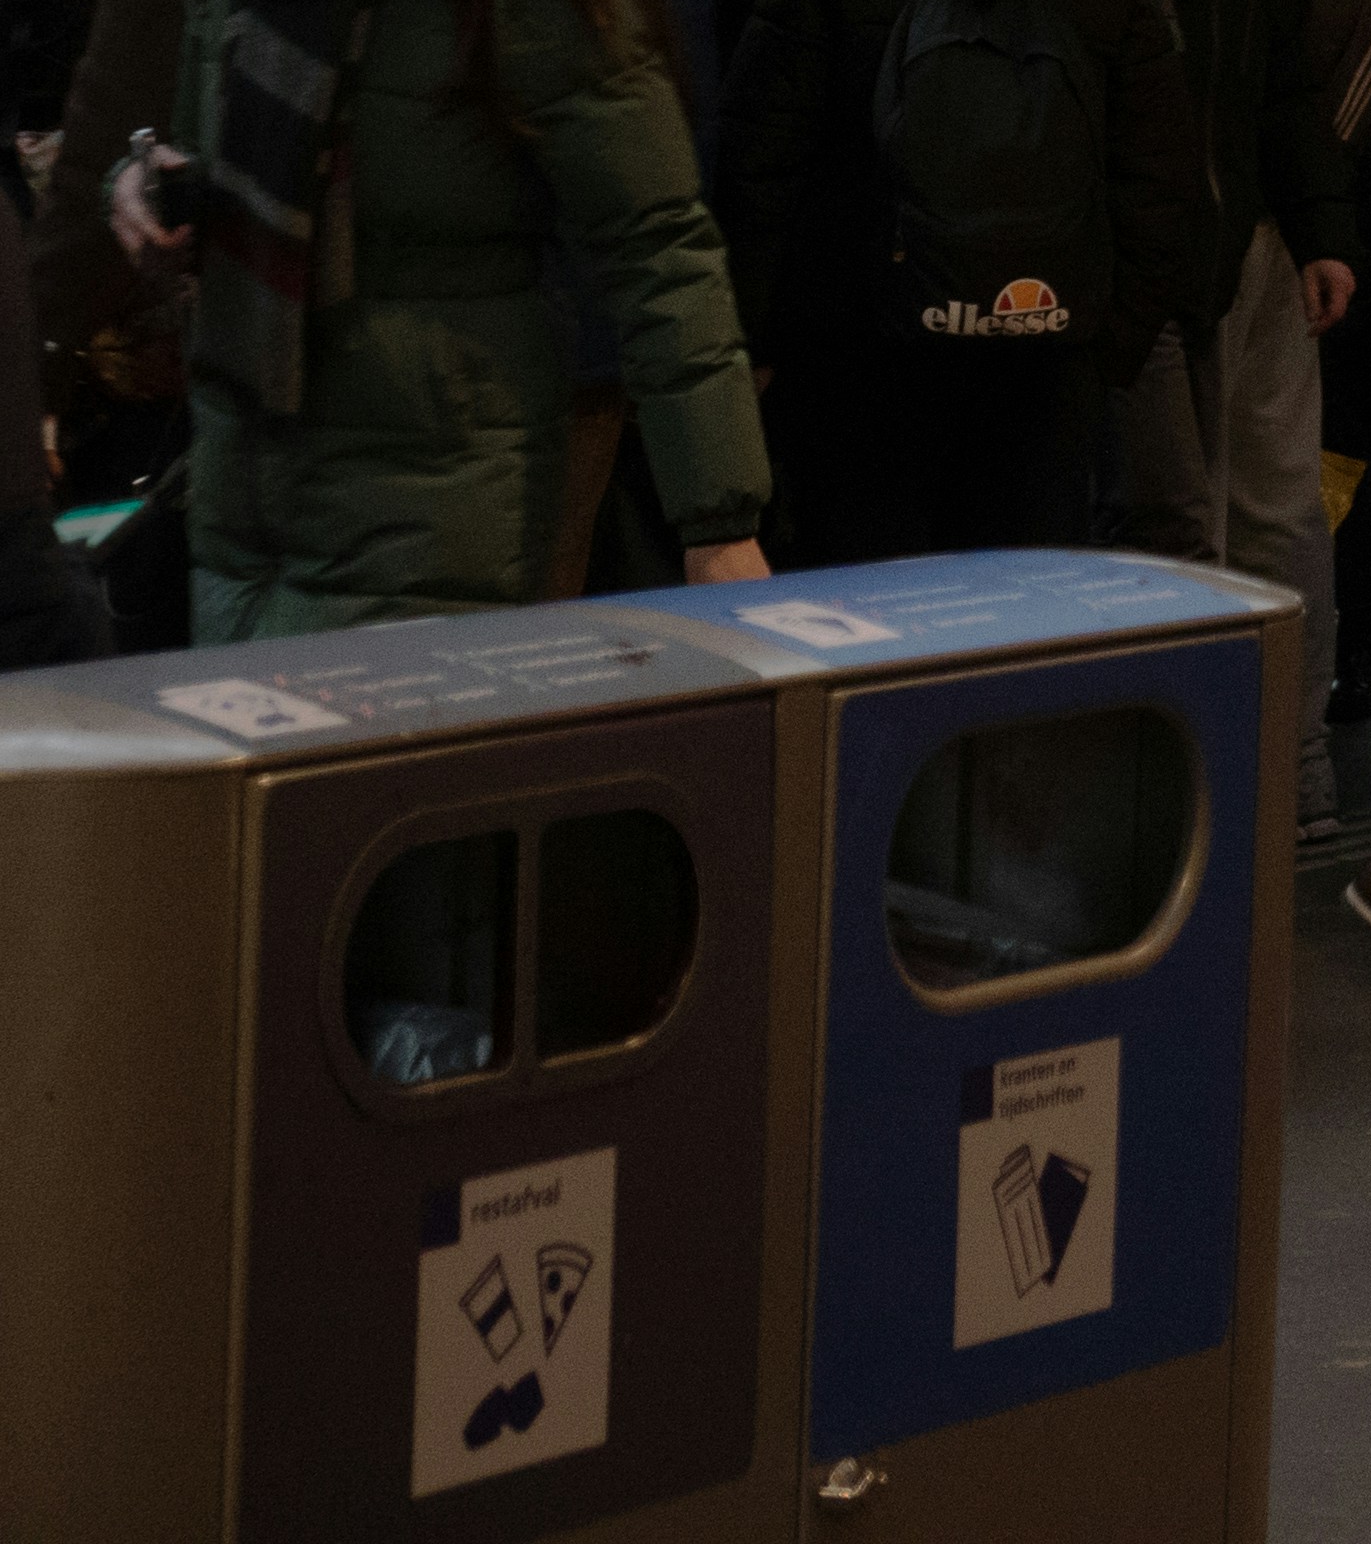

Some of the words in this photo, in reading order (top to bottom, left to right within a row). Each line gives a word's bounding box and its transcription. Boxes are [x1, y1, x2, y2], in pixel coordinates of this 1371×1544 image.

[921, 300, 1071, 337] ellesse
[999, 1064, 1056, 1089] kranten
[1058, 1056, 1078, 1077] en
[998, 1085, 1086, 1121] tijdschriften
[469, 1176, 562, 1224] restafval
